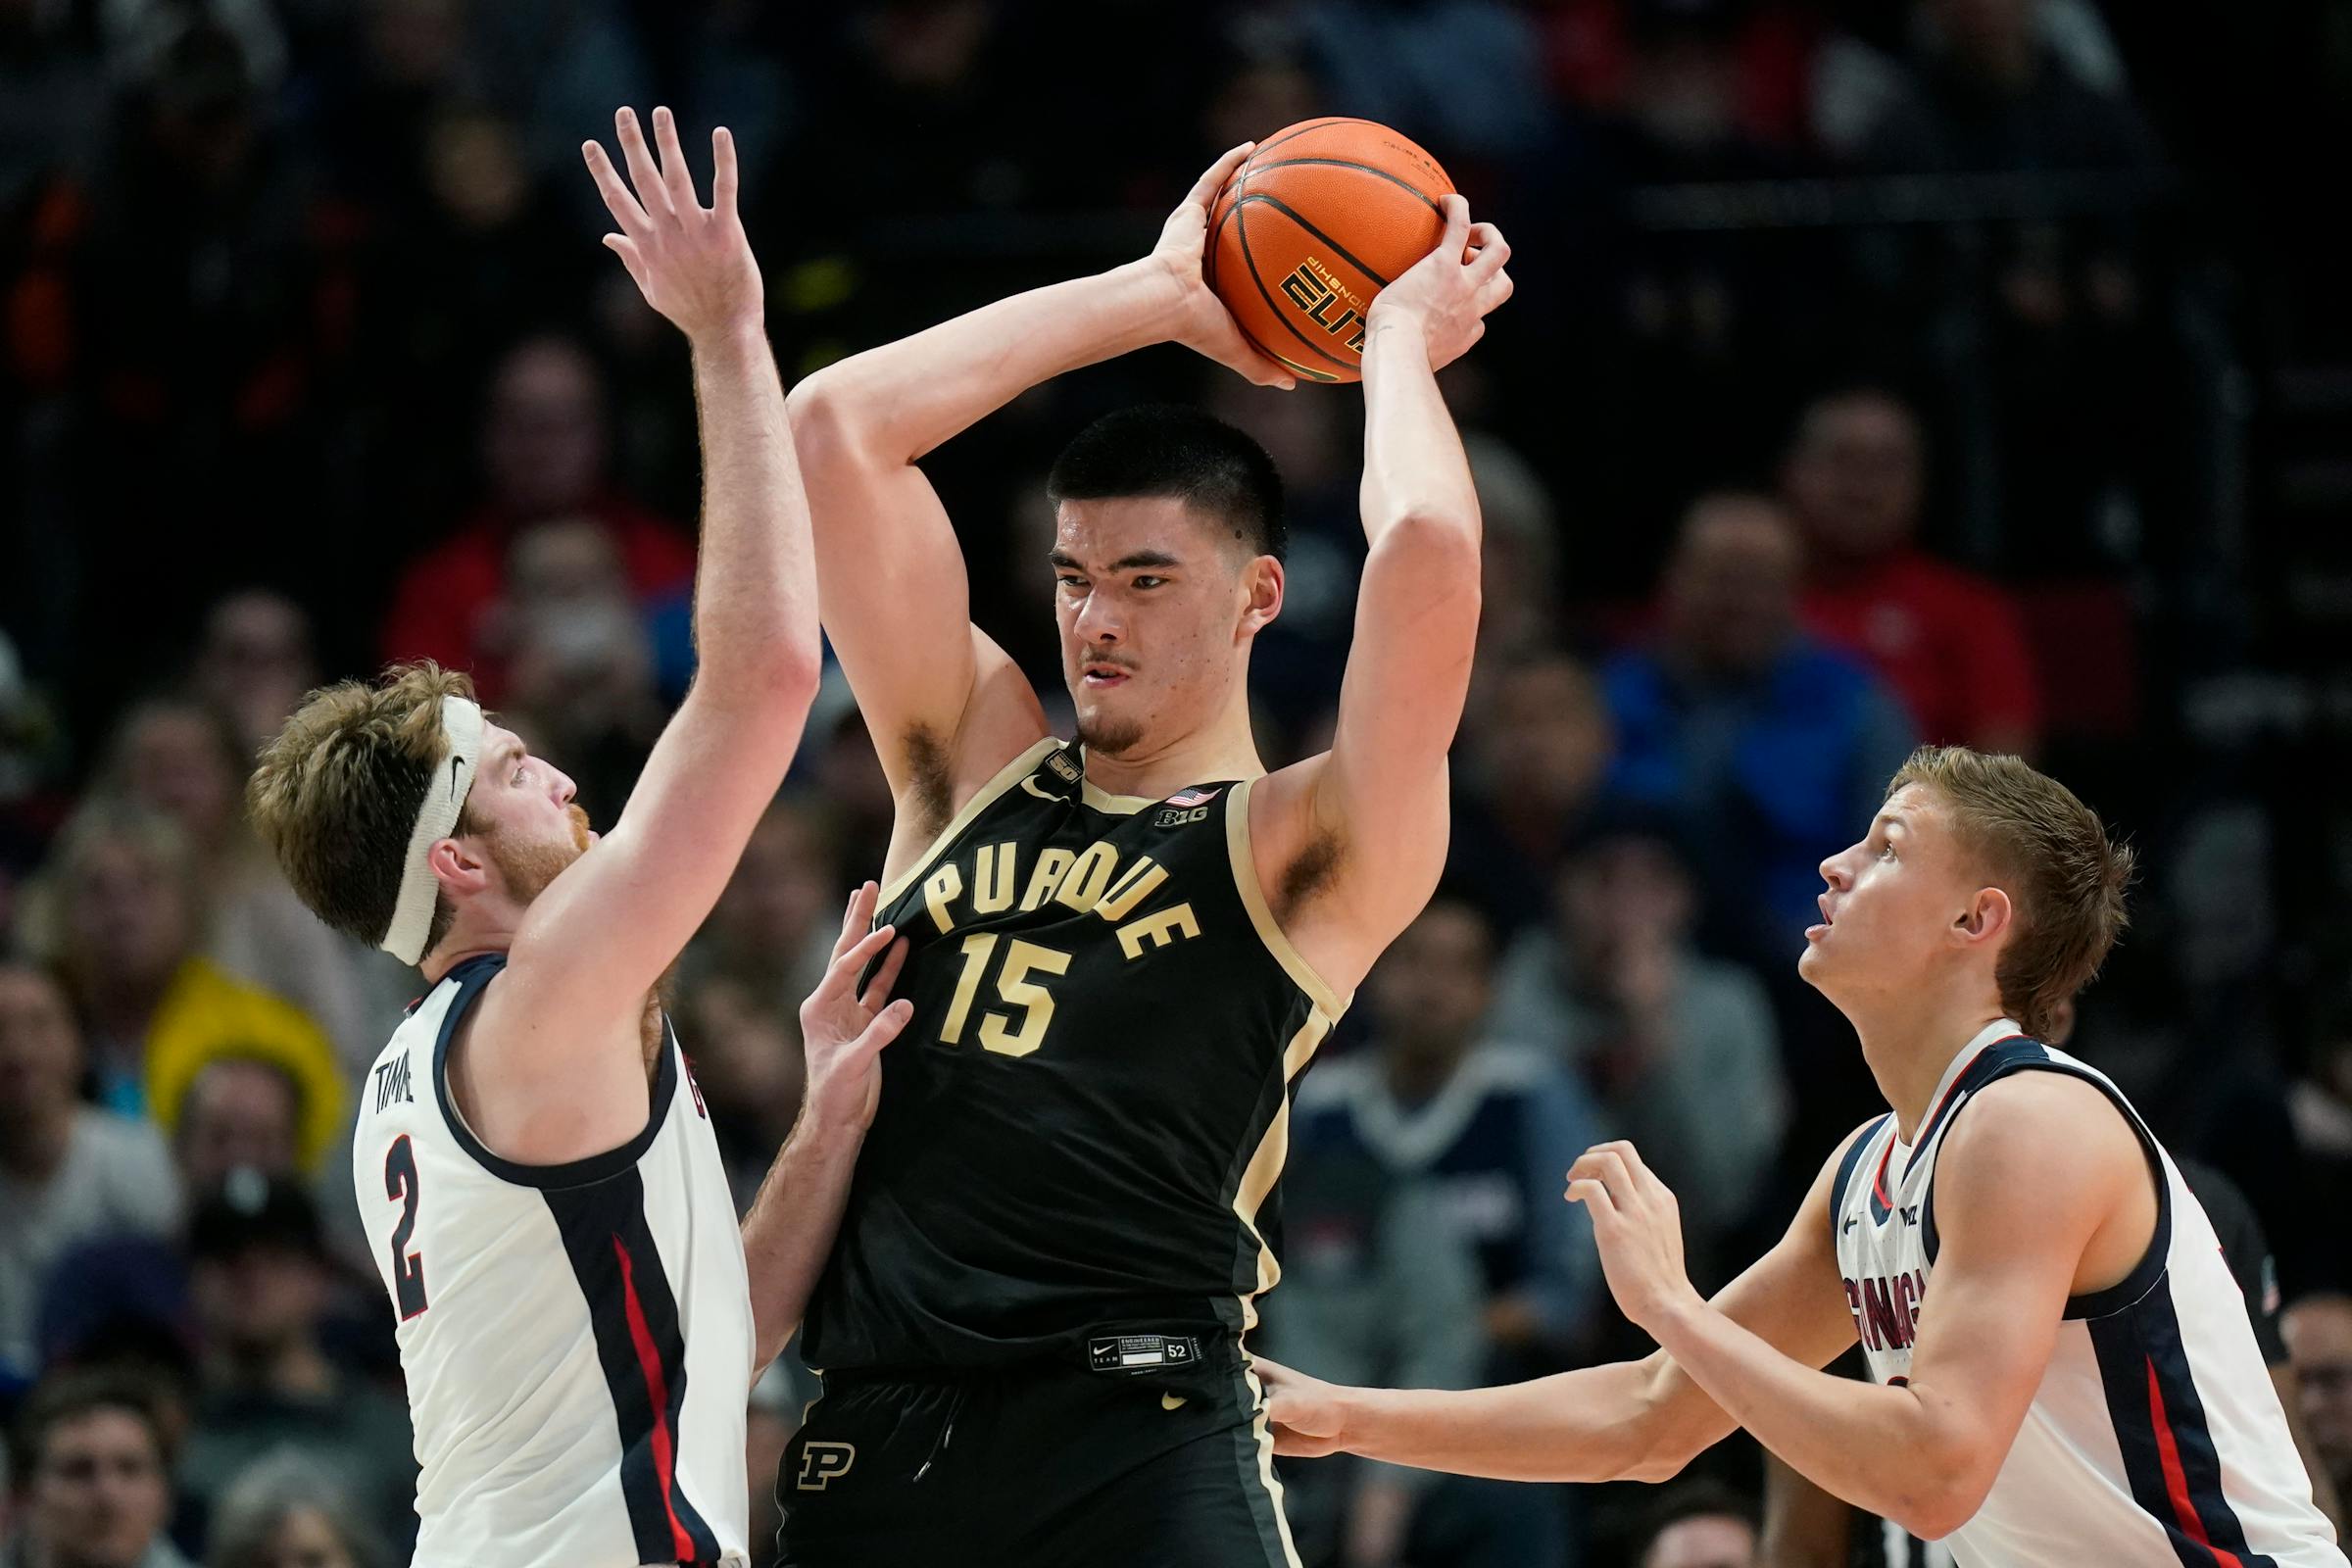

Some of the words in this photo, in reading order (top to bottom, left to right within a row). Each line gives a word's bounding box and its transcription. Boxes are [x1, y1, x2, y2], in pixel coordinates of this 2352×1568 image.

[1279, 263, 1366, 354] ELIT
[923, 840, 1202, 961] PURDUE
[939, 932, 1073, 1057] 15
[385, 1134, 428, 1321] 2
[1168, 1345, 1187, 1358] 52
[797, 1442, 856, 1491] P
